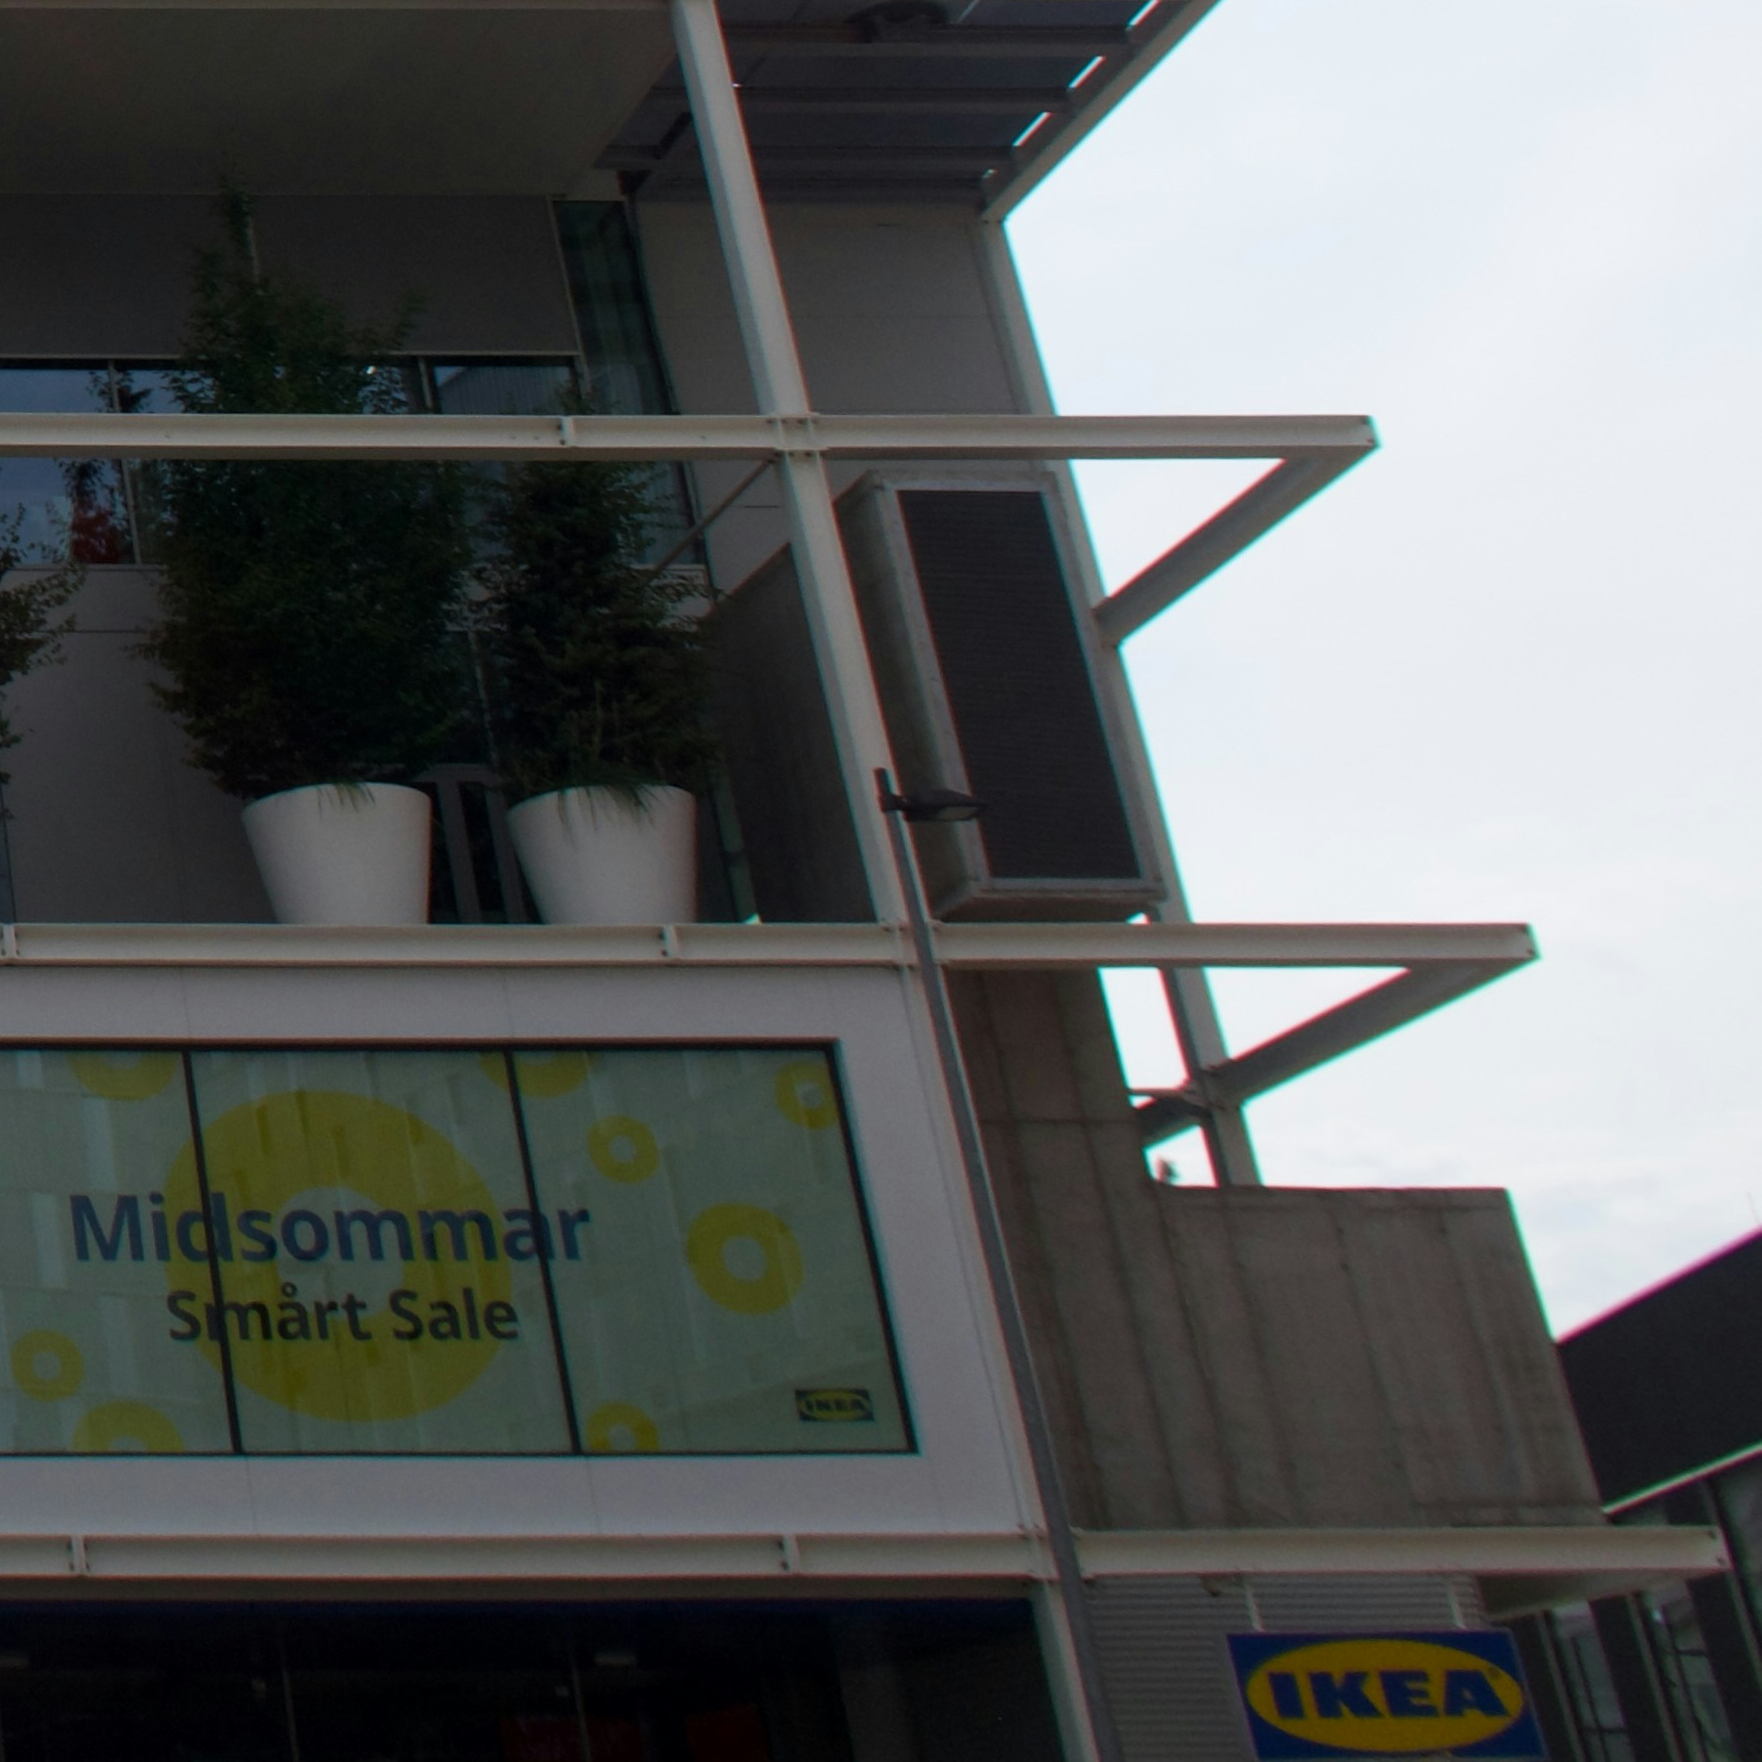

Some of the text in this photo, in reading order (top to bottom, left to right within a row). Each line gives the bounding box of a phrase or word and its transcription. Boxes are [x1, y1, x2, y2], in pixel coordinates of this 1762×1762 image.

[69, 1191, 590, 1262] Midsommar
[167, 1282, 518, 1340] Smårt Sale
